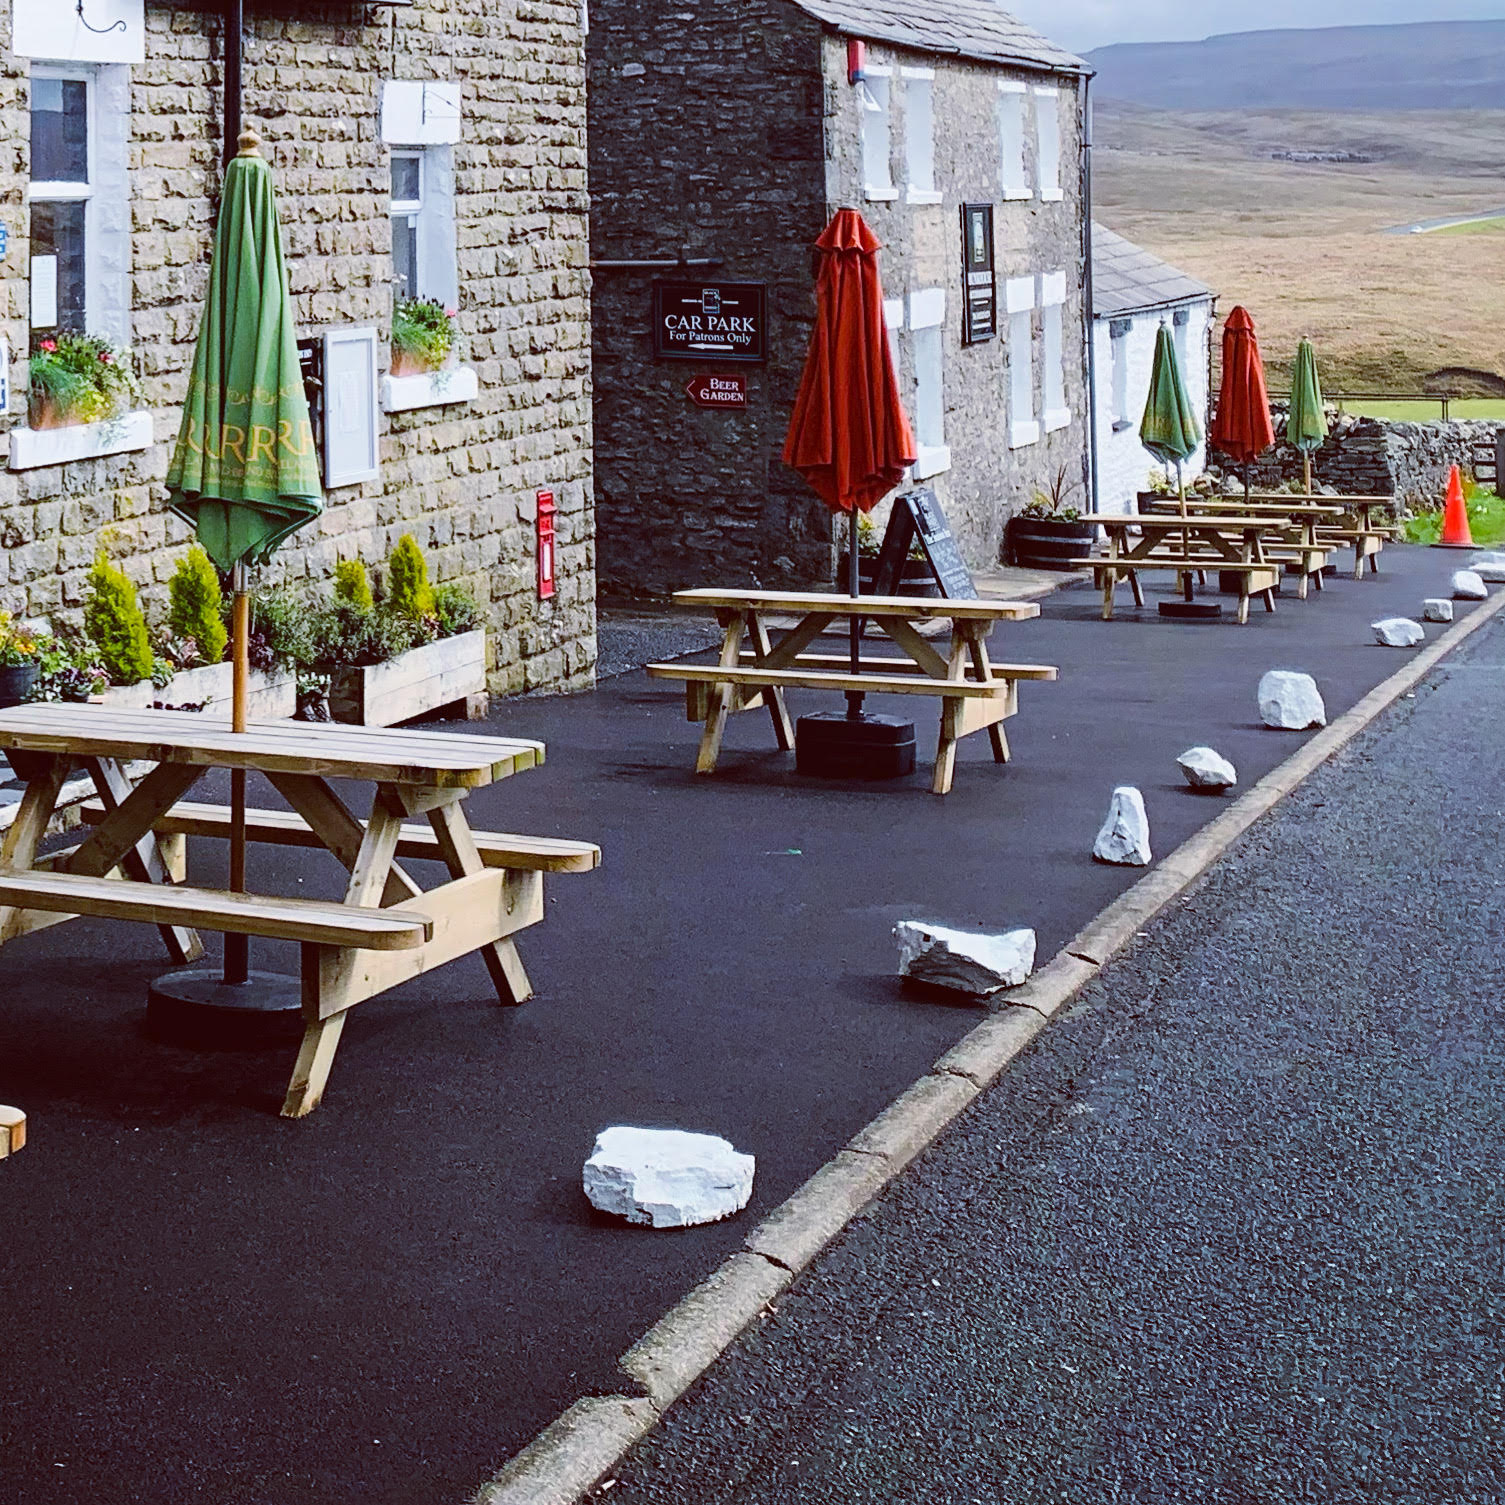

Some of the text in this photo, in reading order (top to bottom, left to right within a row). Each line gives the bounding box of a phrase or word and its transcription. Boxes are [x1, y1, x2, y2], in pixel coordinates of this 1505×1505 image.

[664, 314, 756, 333] CAR PARK
[669, 330, 752, 346] For Patrons Only
[710, 378, 739, 392] BEER
[700, 388, 744, 402] GARDEN
